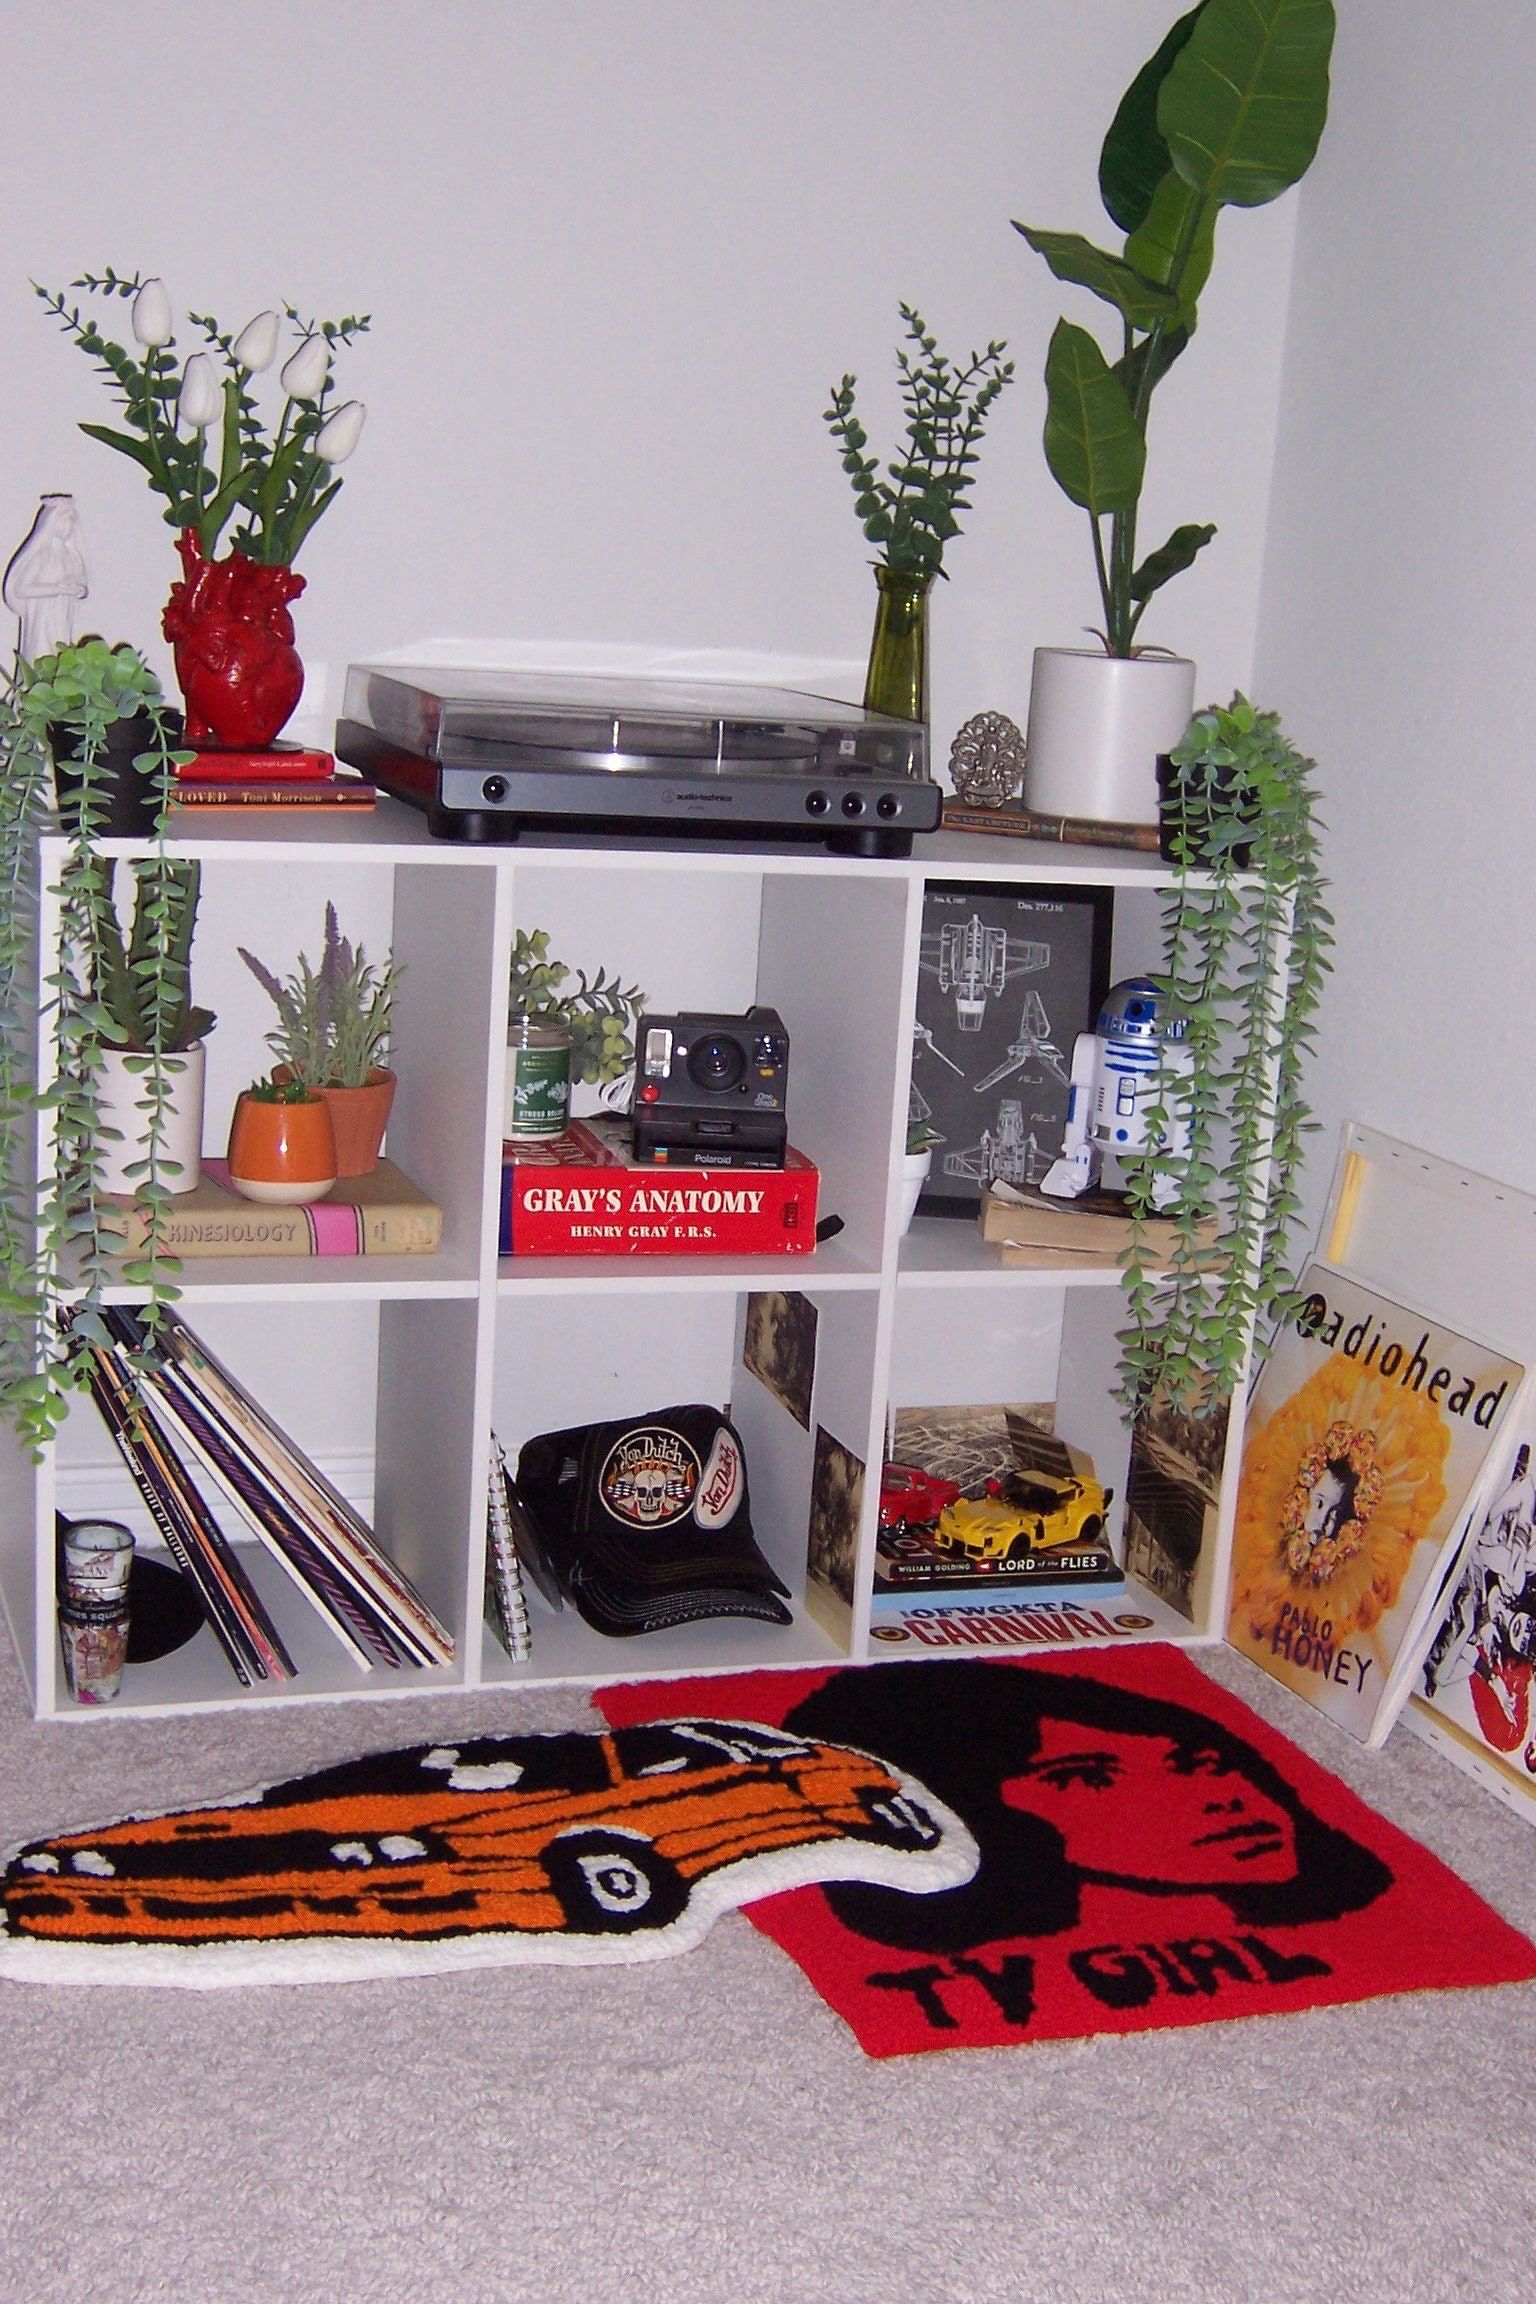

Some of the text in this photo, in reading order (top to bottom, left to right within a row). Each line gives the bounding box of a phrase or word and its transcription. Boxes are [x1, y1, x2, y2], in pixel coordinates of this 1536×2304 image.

[168, 791, 322, 803] LOVED Toni Morrison
[694, 1153, 732, 1165] Polaroid
[523, 1187, 765, 1214] GRAY'S ANATOMY
[169, 1222, 297, 1243] KINESIOLOGY
[570, 1225, 624, 1238] HENRY
[628, 1225, 669, 1239] GRAY
[616, 1435, 687, 1470] Von Dutch
[898, 1563, 932, 1573] WILLIAM
[933, 1562, 971, 1572] GOLDING
[998, 1559, 1036, 1572] LORD
[1060, 1556, 1098, 1569] FLIES
[905, 1601, 1087, 1619] OFWGKTA
[904, 1610, 1132, 1645] CARNIVAL
[1271, 1622, 1374, 1693] HONEY
[865, 1934, 1334, 2029] TV GIRL
